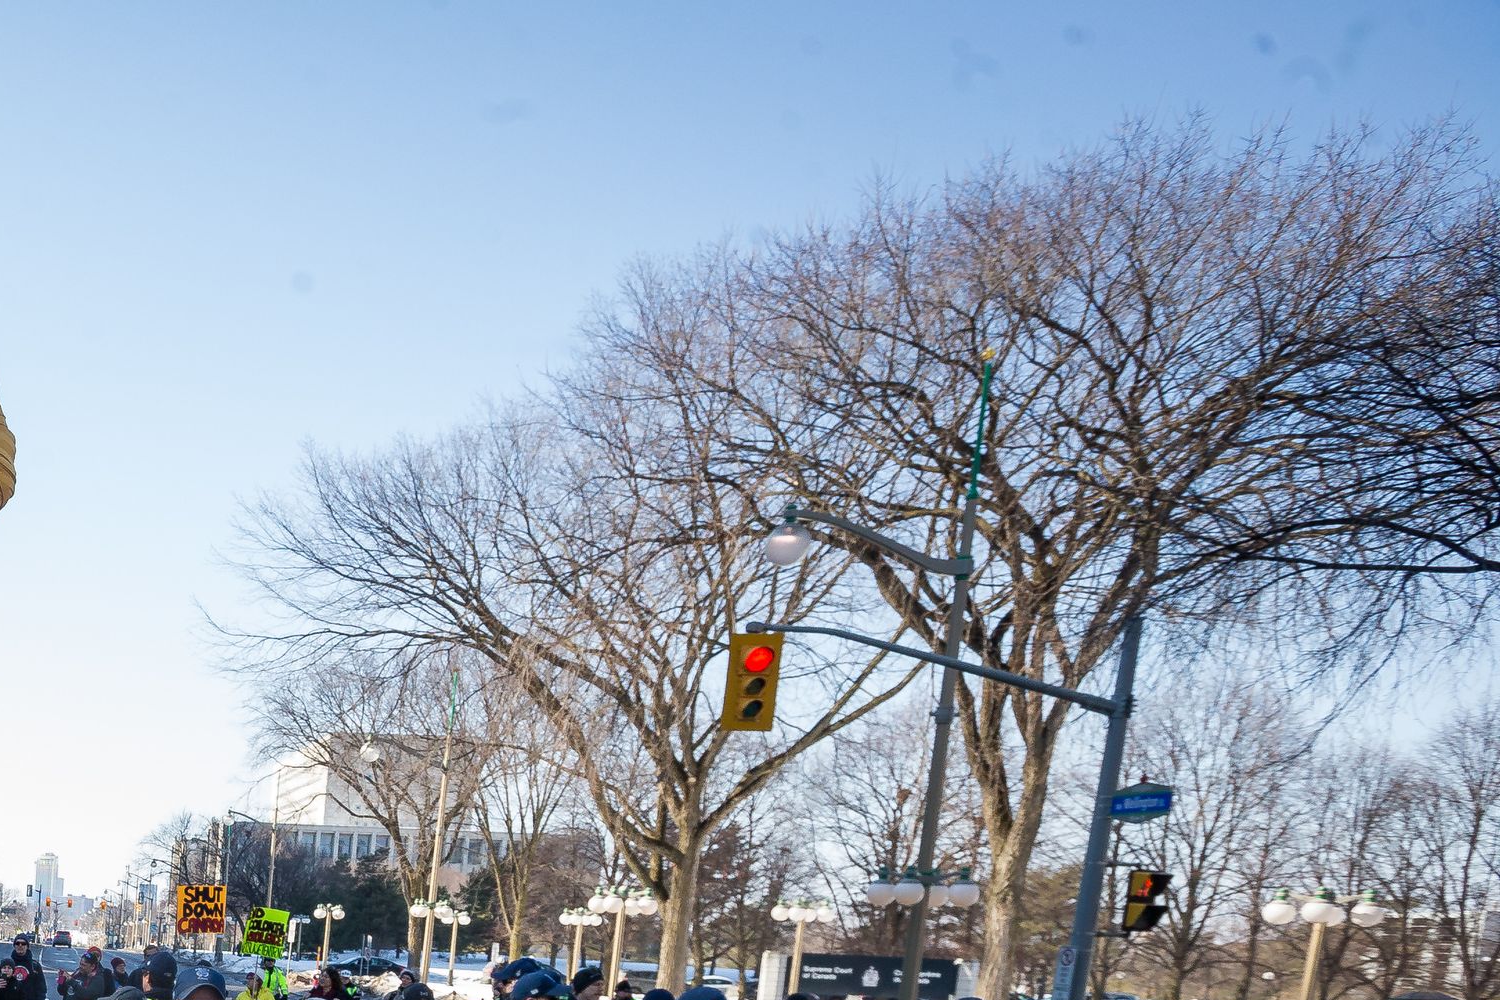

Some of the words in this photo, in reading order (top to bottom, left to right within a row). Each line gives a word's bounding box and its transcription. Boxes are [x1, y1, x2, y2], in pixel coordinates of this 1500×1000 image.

[183, 886, 223, 903] SHUT
[182, 902, 223, 918] DOWN
[177, 917, 224, 934] CANADA
